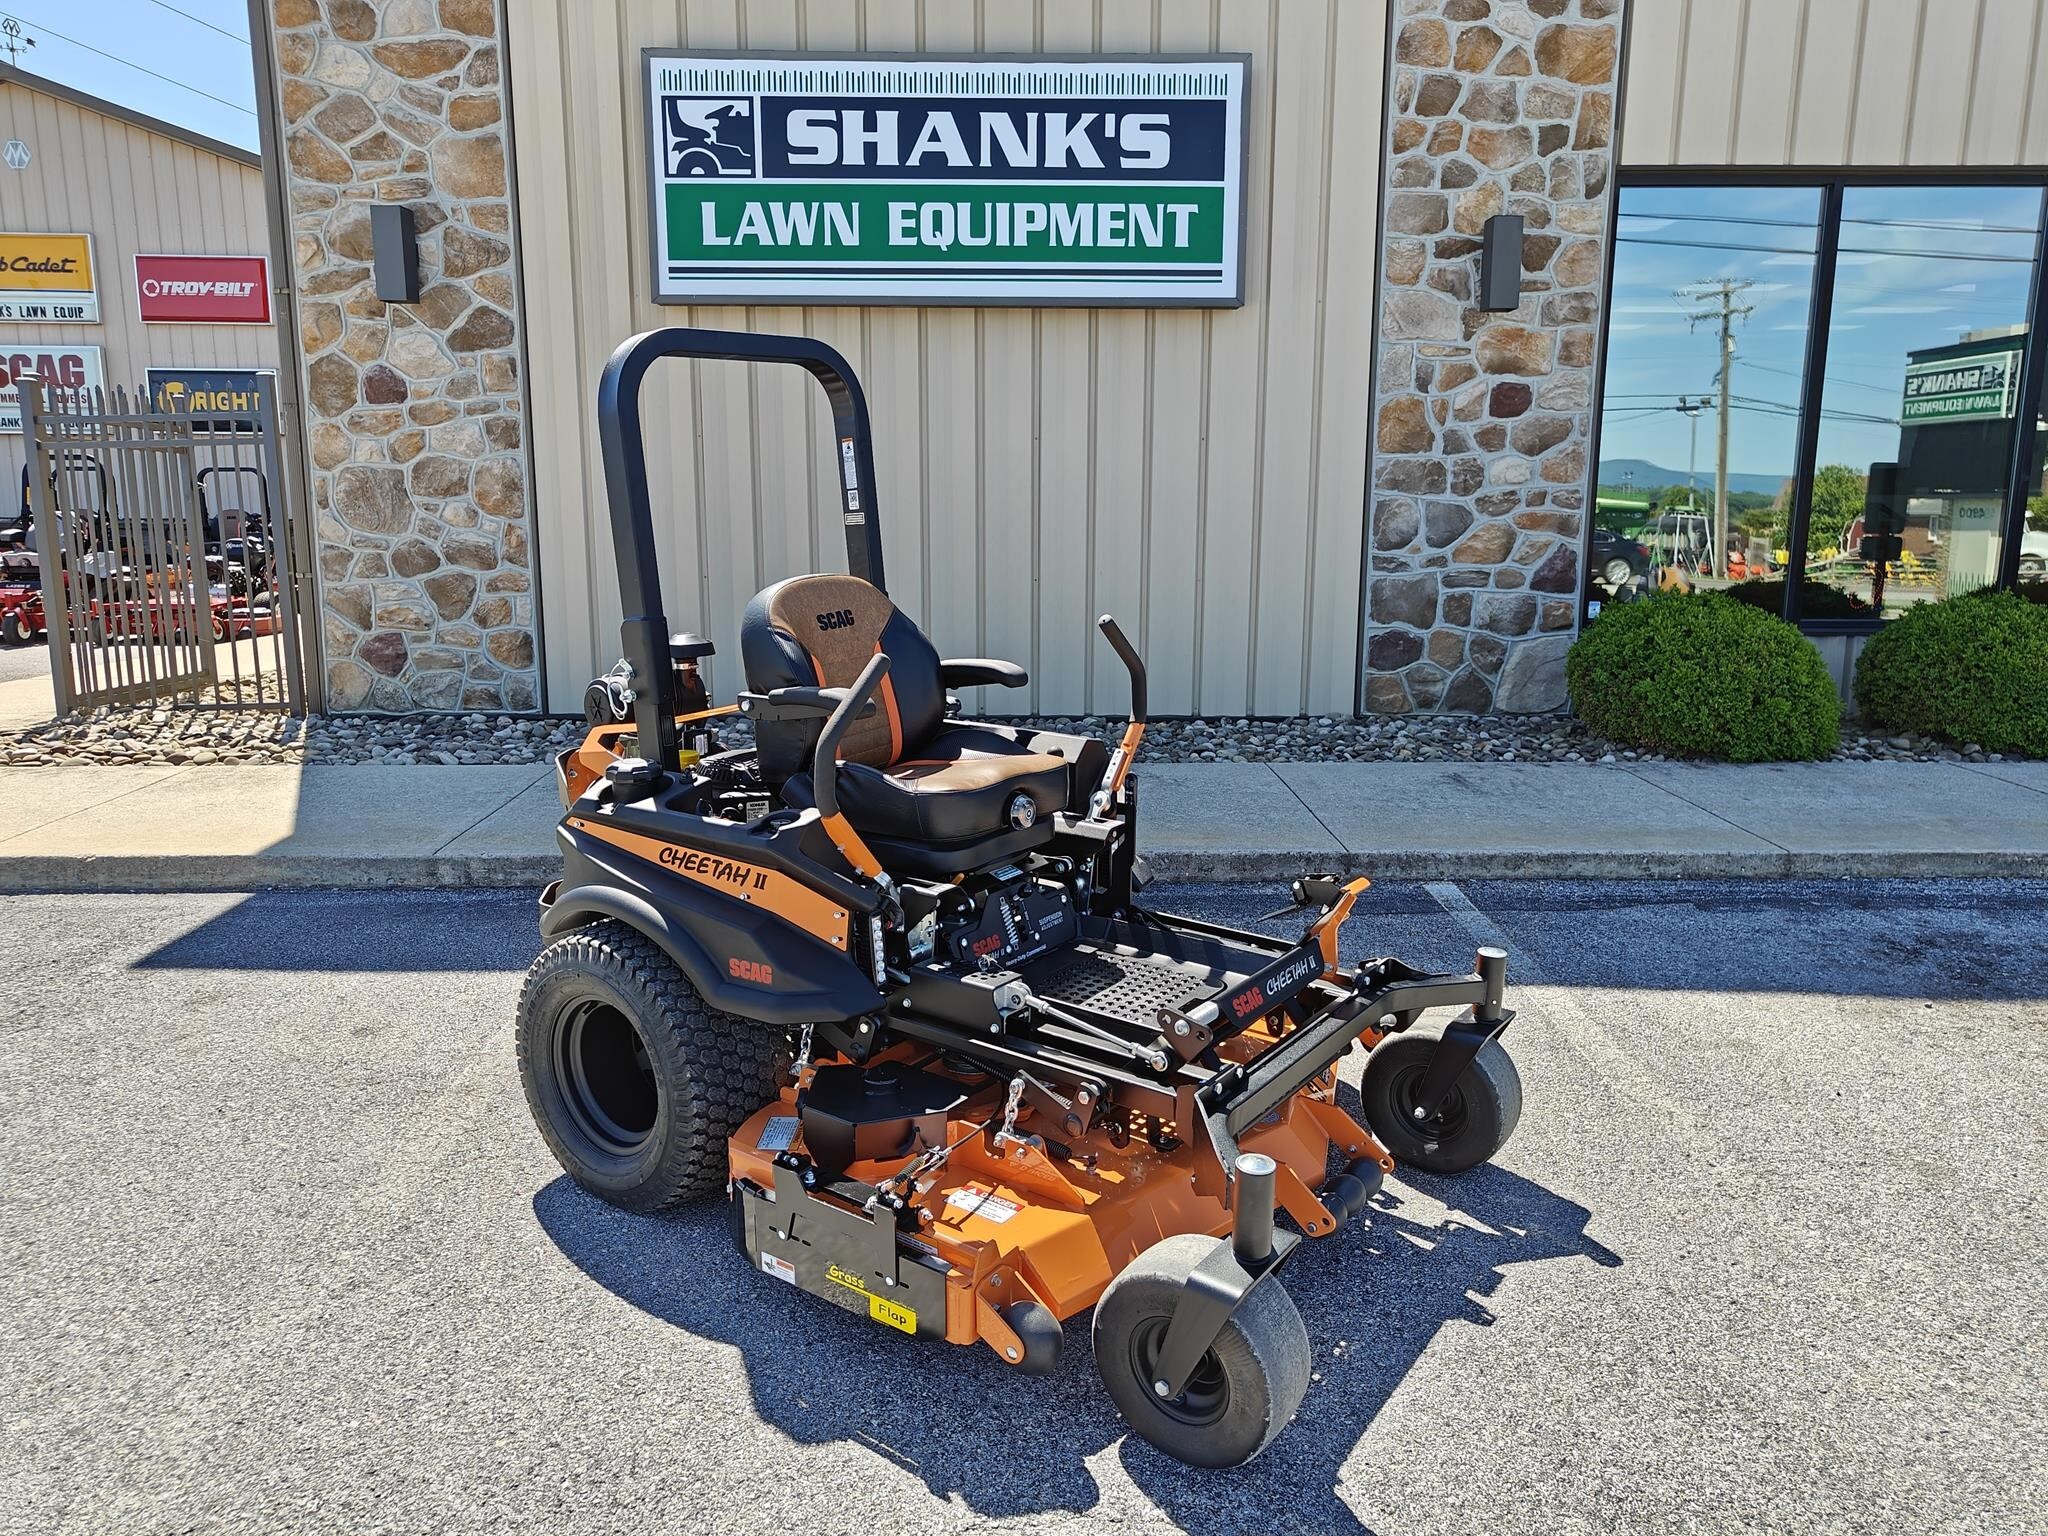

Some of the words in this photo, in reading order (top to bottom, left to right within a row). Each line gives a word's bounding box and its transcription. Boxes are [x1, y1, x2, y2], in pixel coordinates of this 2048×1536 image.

[786, 109, 1172, 170] SHANK'S
[700, 201, 860, 247] LAWN
[887, 201, 1200, 251] EQUIPMENT
[10, 256, 77, 273] Cadet
[160, 281, 254, 297] TROY-BILT
[19, 306, 47, 318] LAWN
[816, 609, 855, 632] SCAG
[658, 847, 751, 887] CHEETAH
[753, 872, 768, 890] II
[972, 934, 1001, 955] SCAG
[728, 958, 773, 985] SCAG
[1232, 987, 1264, 1018] SCAG
[1266, 957, 1309, 996] CHEETAH
[979, 1192, 1018, 1211] DANGER
[829, 1265, 865, 1289] Grass
[878, 1303, 907, 1326] Flap
